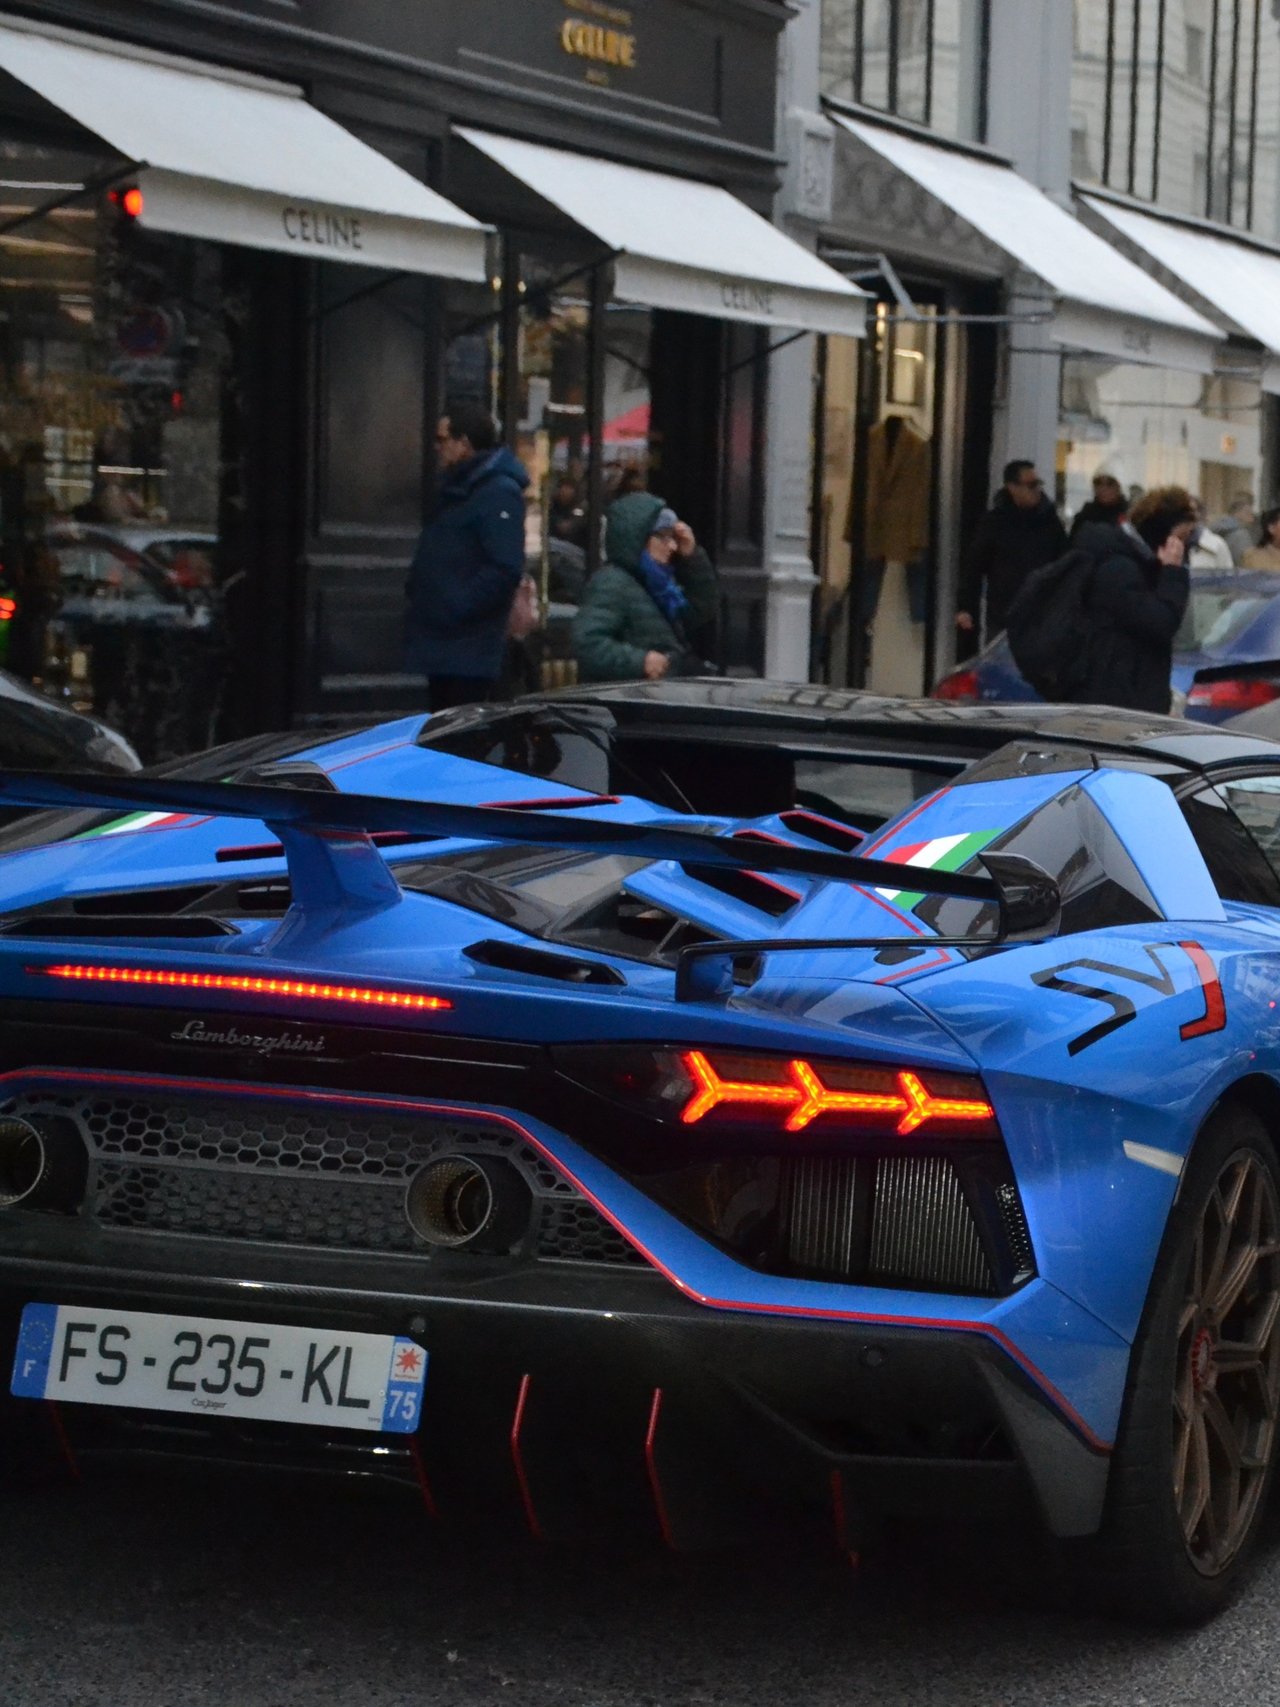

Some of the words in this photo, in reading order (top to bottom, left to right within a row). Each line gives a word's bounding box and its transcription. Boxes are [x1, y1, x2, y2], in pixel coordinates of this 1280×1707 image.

[282, 206, 362, 249] CELINE
[1030, 940, 1227, 1057] SVJ
[170, 1020, 325, 1057] Lamborghini
[22, 1359, 37, 1377] F
[59, 1321, 370, 1409] FS-235-KL
[389, 1389, 418, 1420] 75
